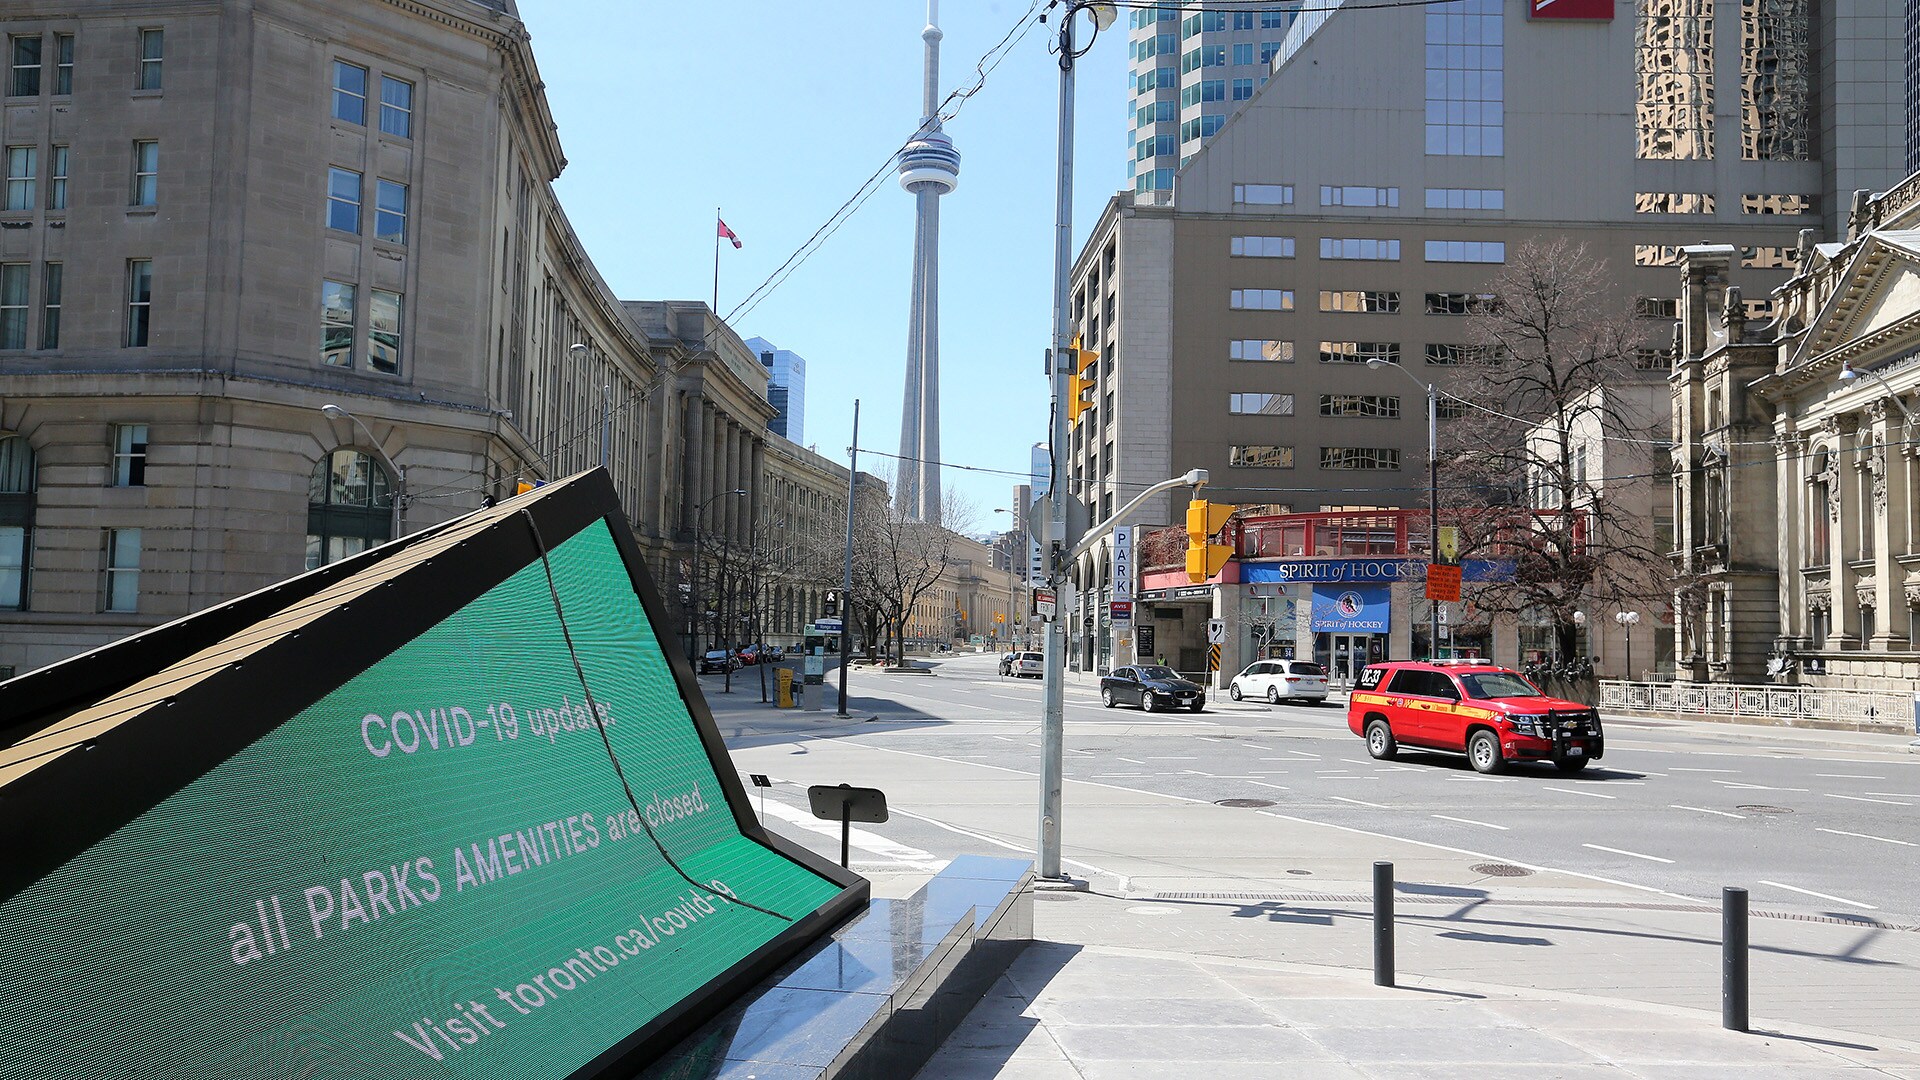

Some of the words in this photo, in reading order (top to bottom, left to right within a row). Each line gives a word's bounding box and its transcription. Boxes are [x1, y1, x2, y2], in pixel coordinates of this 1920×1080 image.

[1117, 533, 1127, 593] PARK
[1280, 563, 1330, 579] SPIRIT
[1332, 562, 1348, 582] of
[1314, 620, 1340, 628] SPIRIT
[1340, 621, 1348, 630] of
[1348, 620, 1384, 629] HOCKEY
[1361, 668, 1382, 684] DC-33
[361, 701, 520, 757] COVID-19
[527, 695, 616, 744] update:
[228, 895, 291, 965] all
[303, 856, 442, 938] PARKS
[454, 812, 600, 891] AMENITIES
[605, 809, 642, 841] are
[646, 781, 709, 828] closed.
[393, 1000, 507, 1062] Visit
[493, 879, 737, 1015] toronto.ca/covid-19
